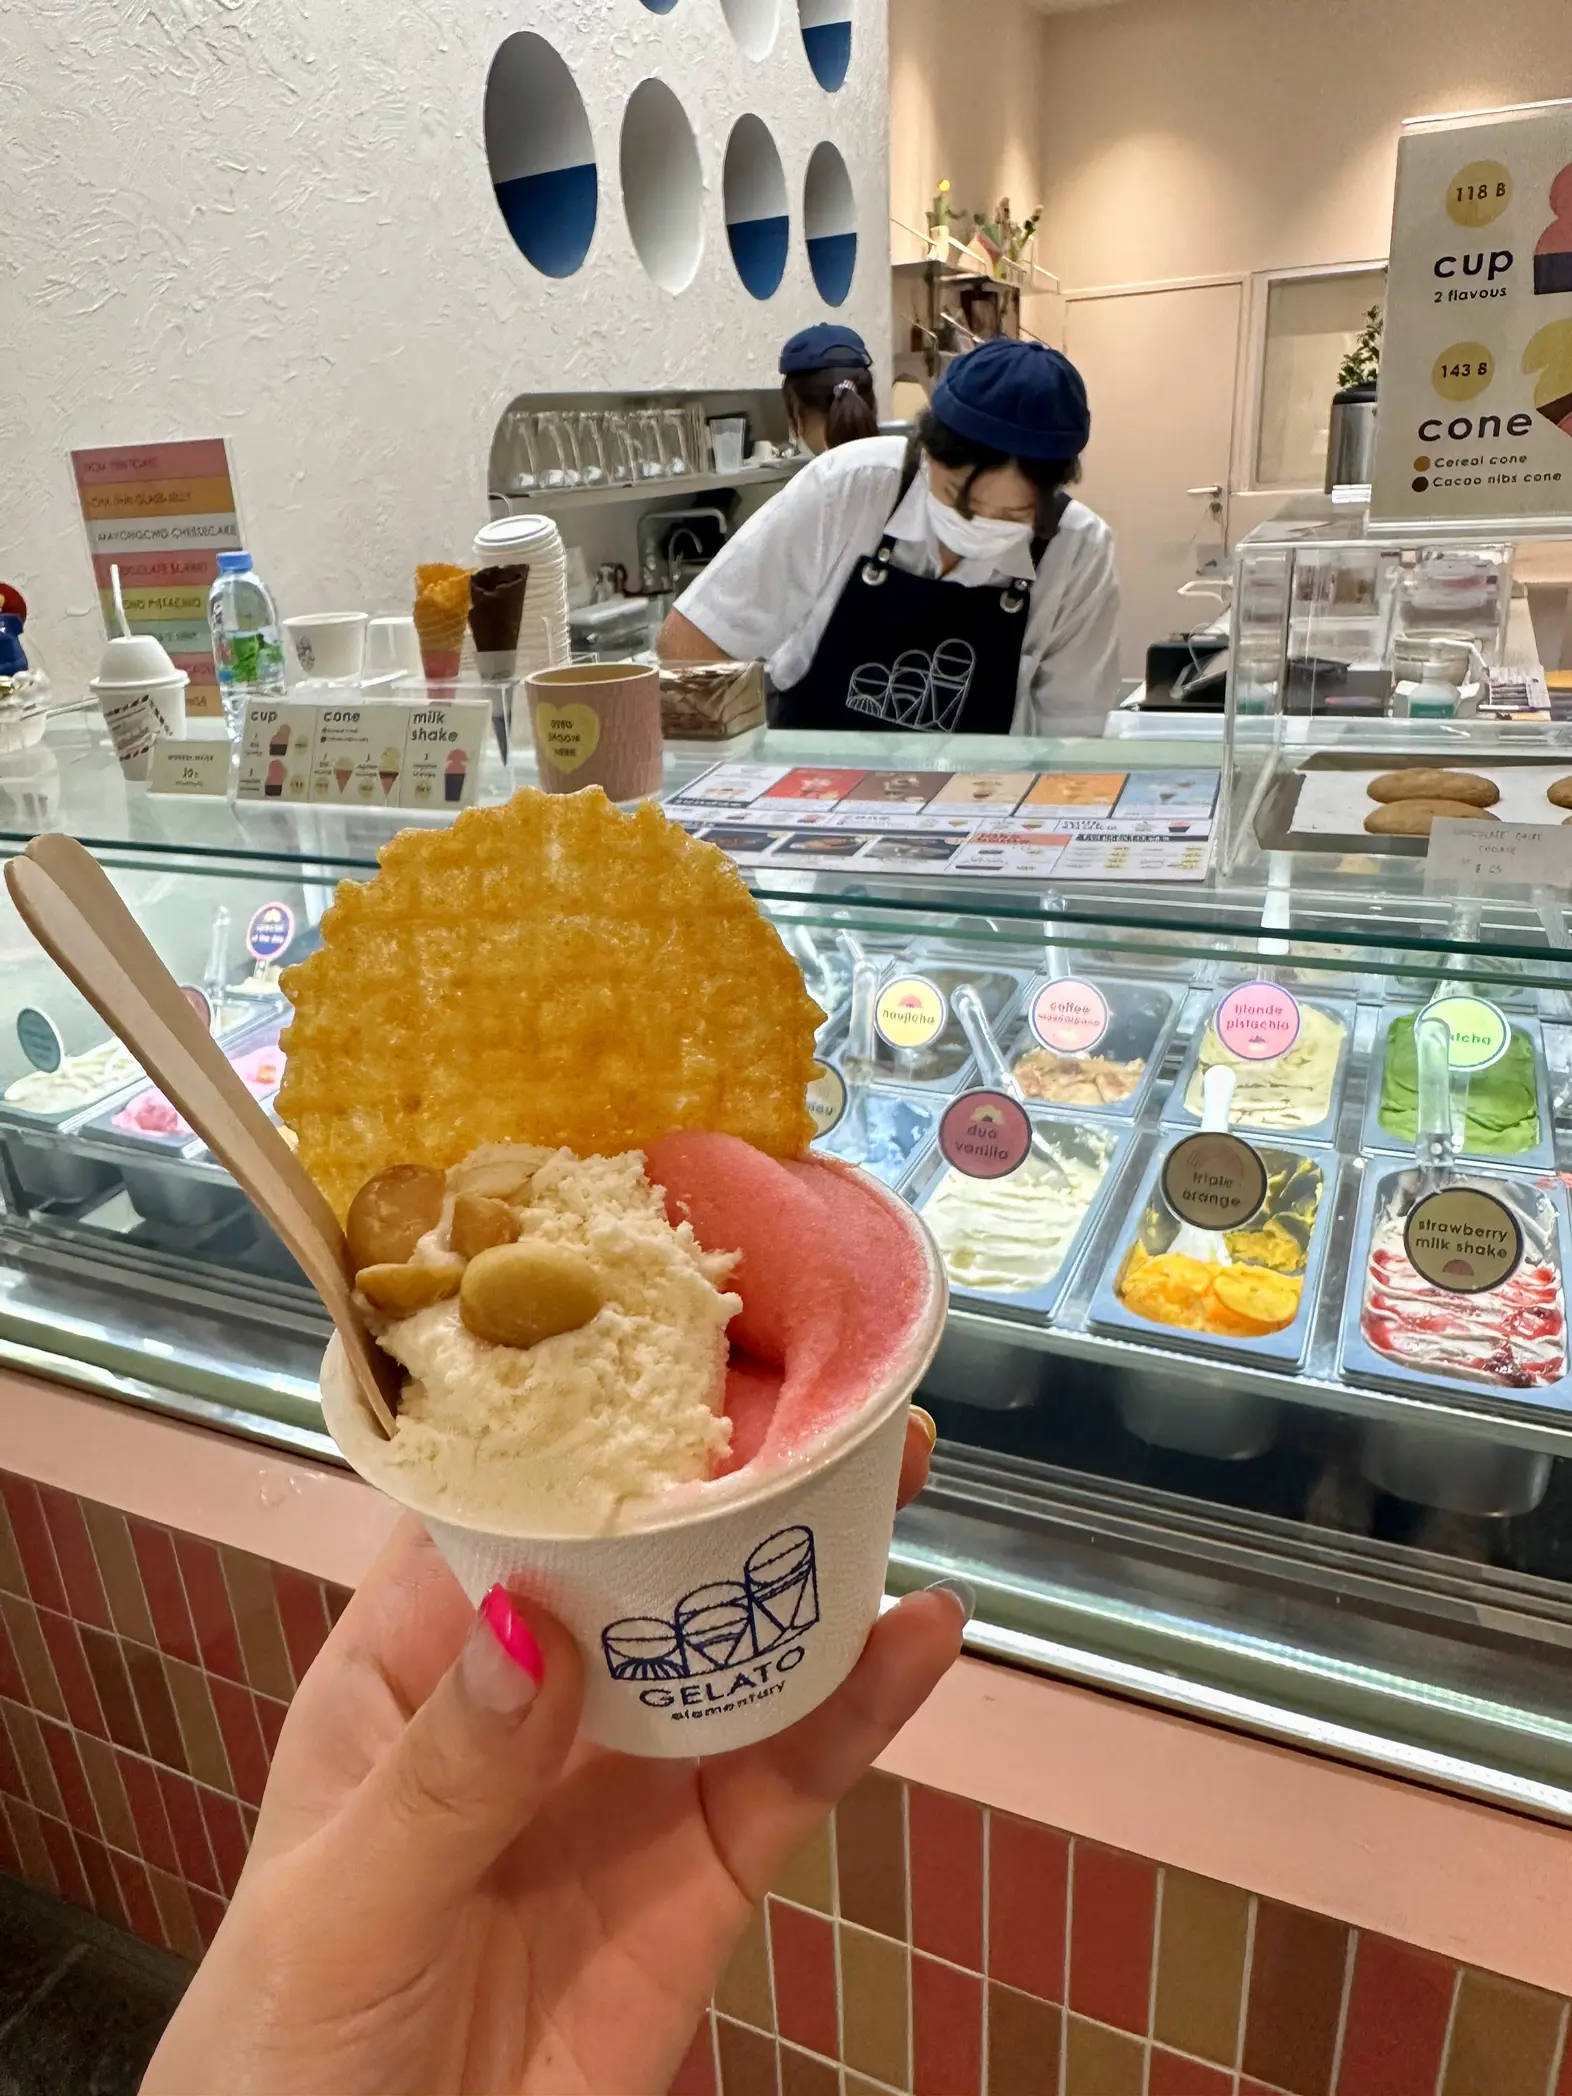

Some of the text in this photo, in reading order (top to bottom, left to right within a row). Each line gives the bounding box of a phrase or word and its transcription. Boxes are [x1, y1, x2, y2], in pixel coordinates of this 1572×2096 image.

[1456, 184, 1488, 202] 118
[1434, 250, 1513, 281] cup
[1434, 287, 1507, 303] 2 flavous
[1441, 363, 1470, 378] 143
[1418, 413, 1532, 442] cone
[1434, 454, 1527, 468] Cereal cone
[1433, 472, 1562, 488] Cacao nibs cone
[250, 711, 279, 724] cup
[323, 711, 361, 723] cone
[413, 710, 446, 725] milk
[411, 727, 458, 743] shake
[1050, 1002, 1091, 1015] coffee
[1235, 1004, 1283, 1015] blonde
[1227, 1018, 1289, 1031] pistachio
[1450, 1032, 1492, 1046] tcha
[955, 1141, 1008, 1160] vanilla
[1193, 1171, 1233, 1189] triple
[1182, 1190, 1241, 1209] orange
[1418, 1219, 1508, 1242] strawberry
[1416, 1236, 1507, 1259] milk shake
[639, 1645, 805, 1708] GELATO
[671, 1680, 786, 1721] elementary
